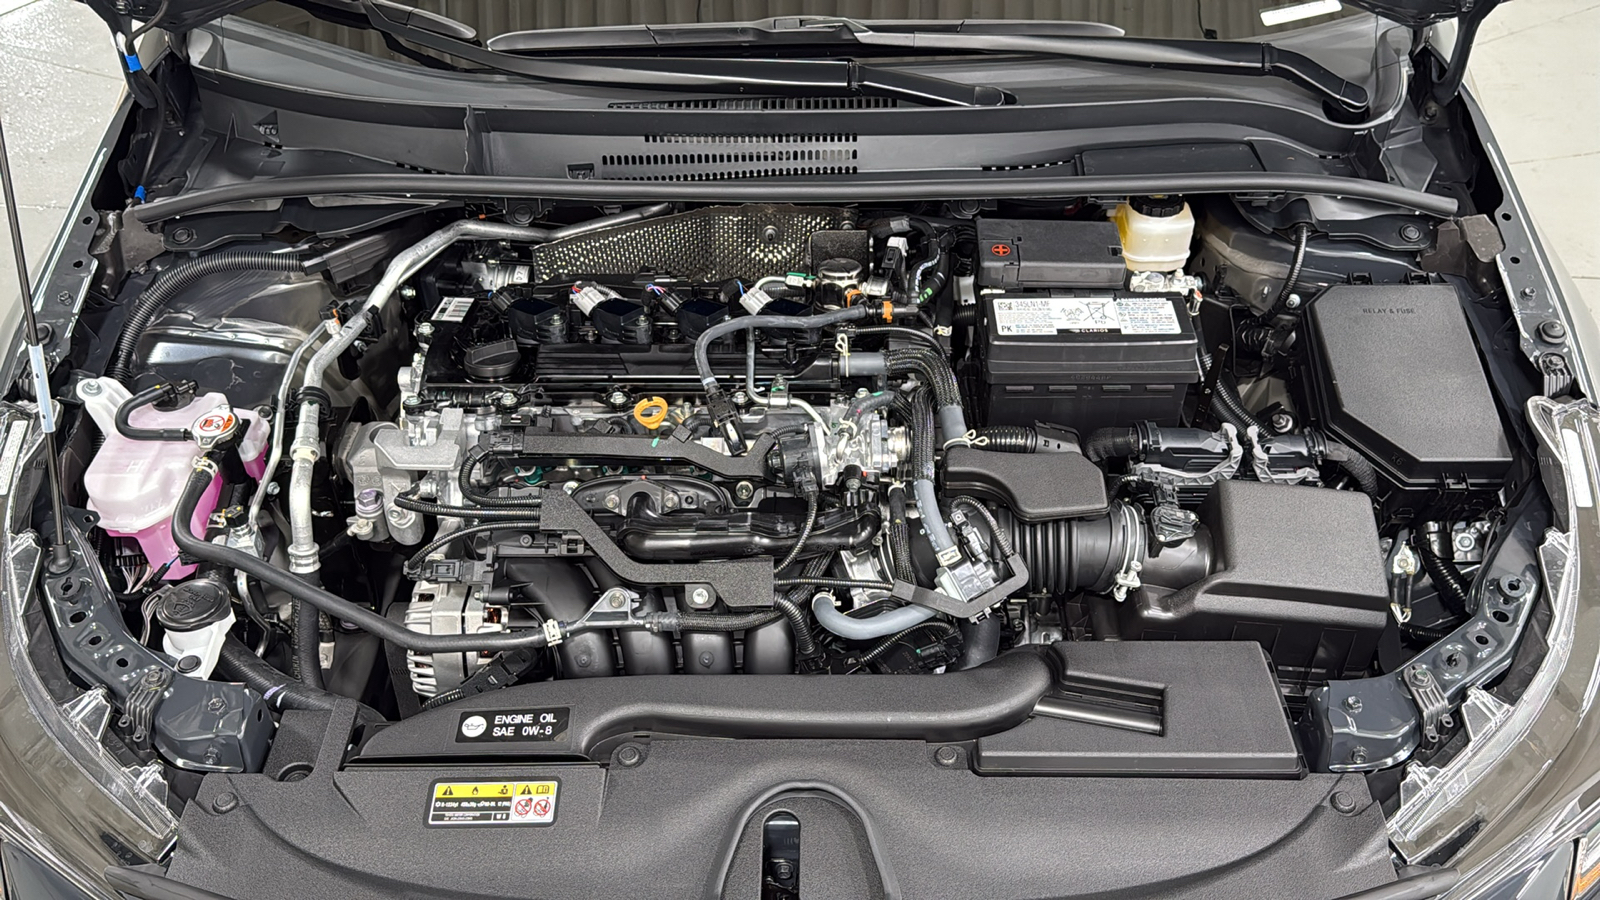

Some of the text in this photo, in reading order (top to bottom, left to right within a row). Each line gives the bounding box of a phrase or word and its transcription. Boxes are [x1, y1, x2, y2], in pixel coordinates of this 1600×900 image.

[1001, 325, 1013, 333] PK
[494, 713, 557, 724] ENGINE OIL
[493, 726, 552, 736] SAE 0W-8
